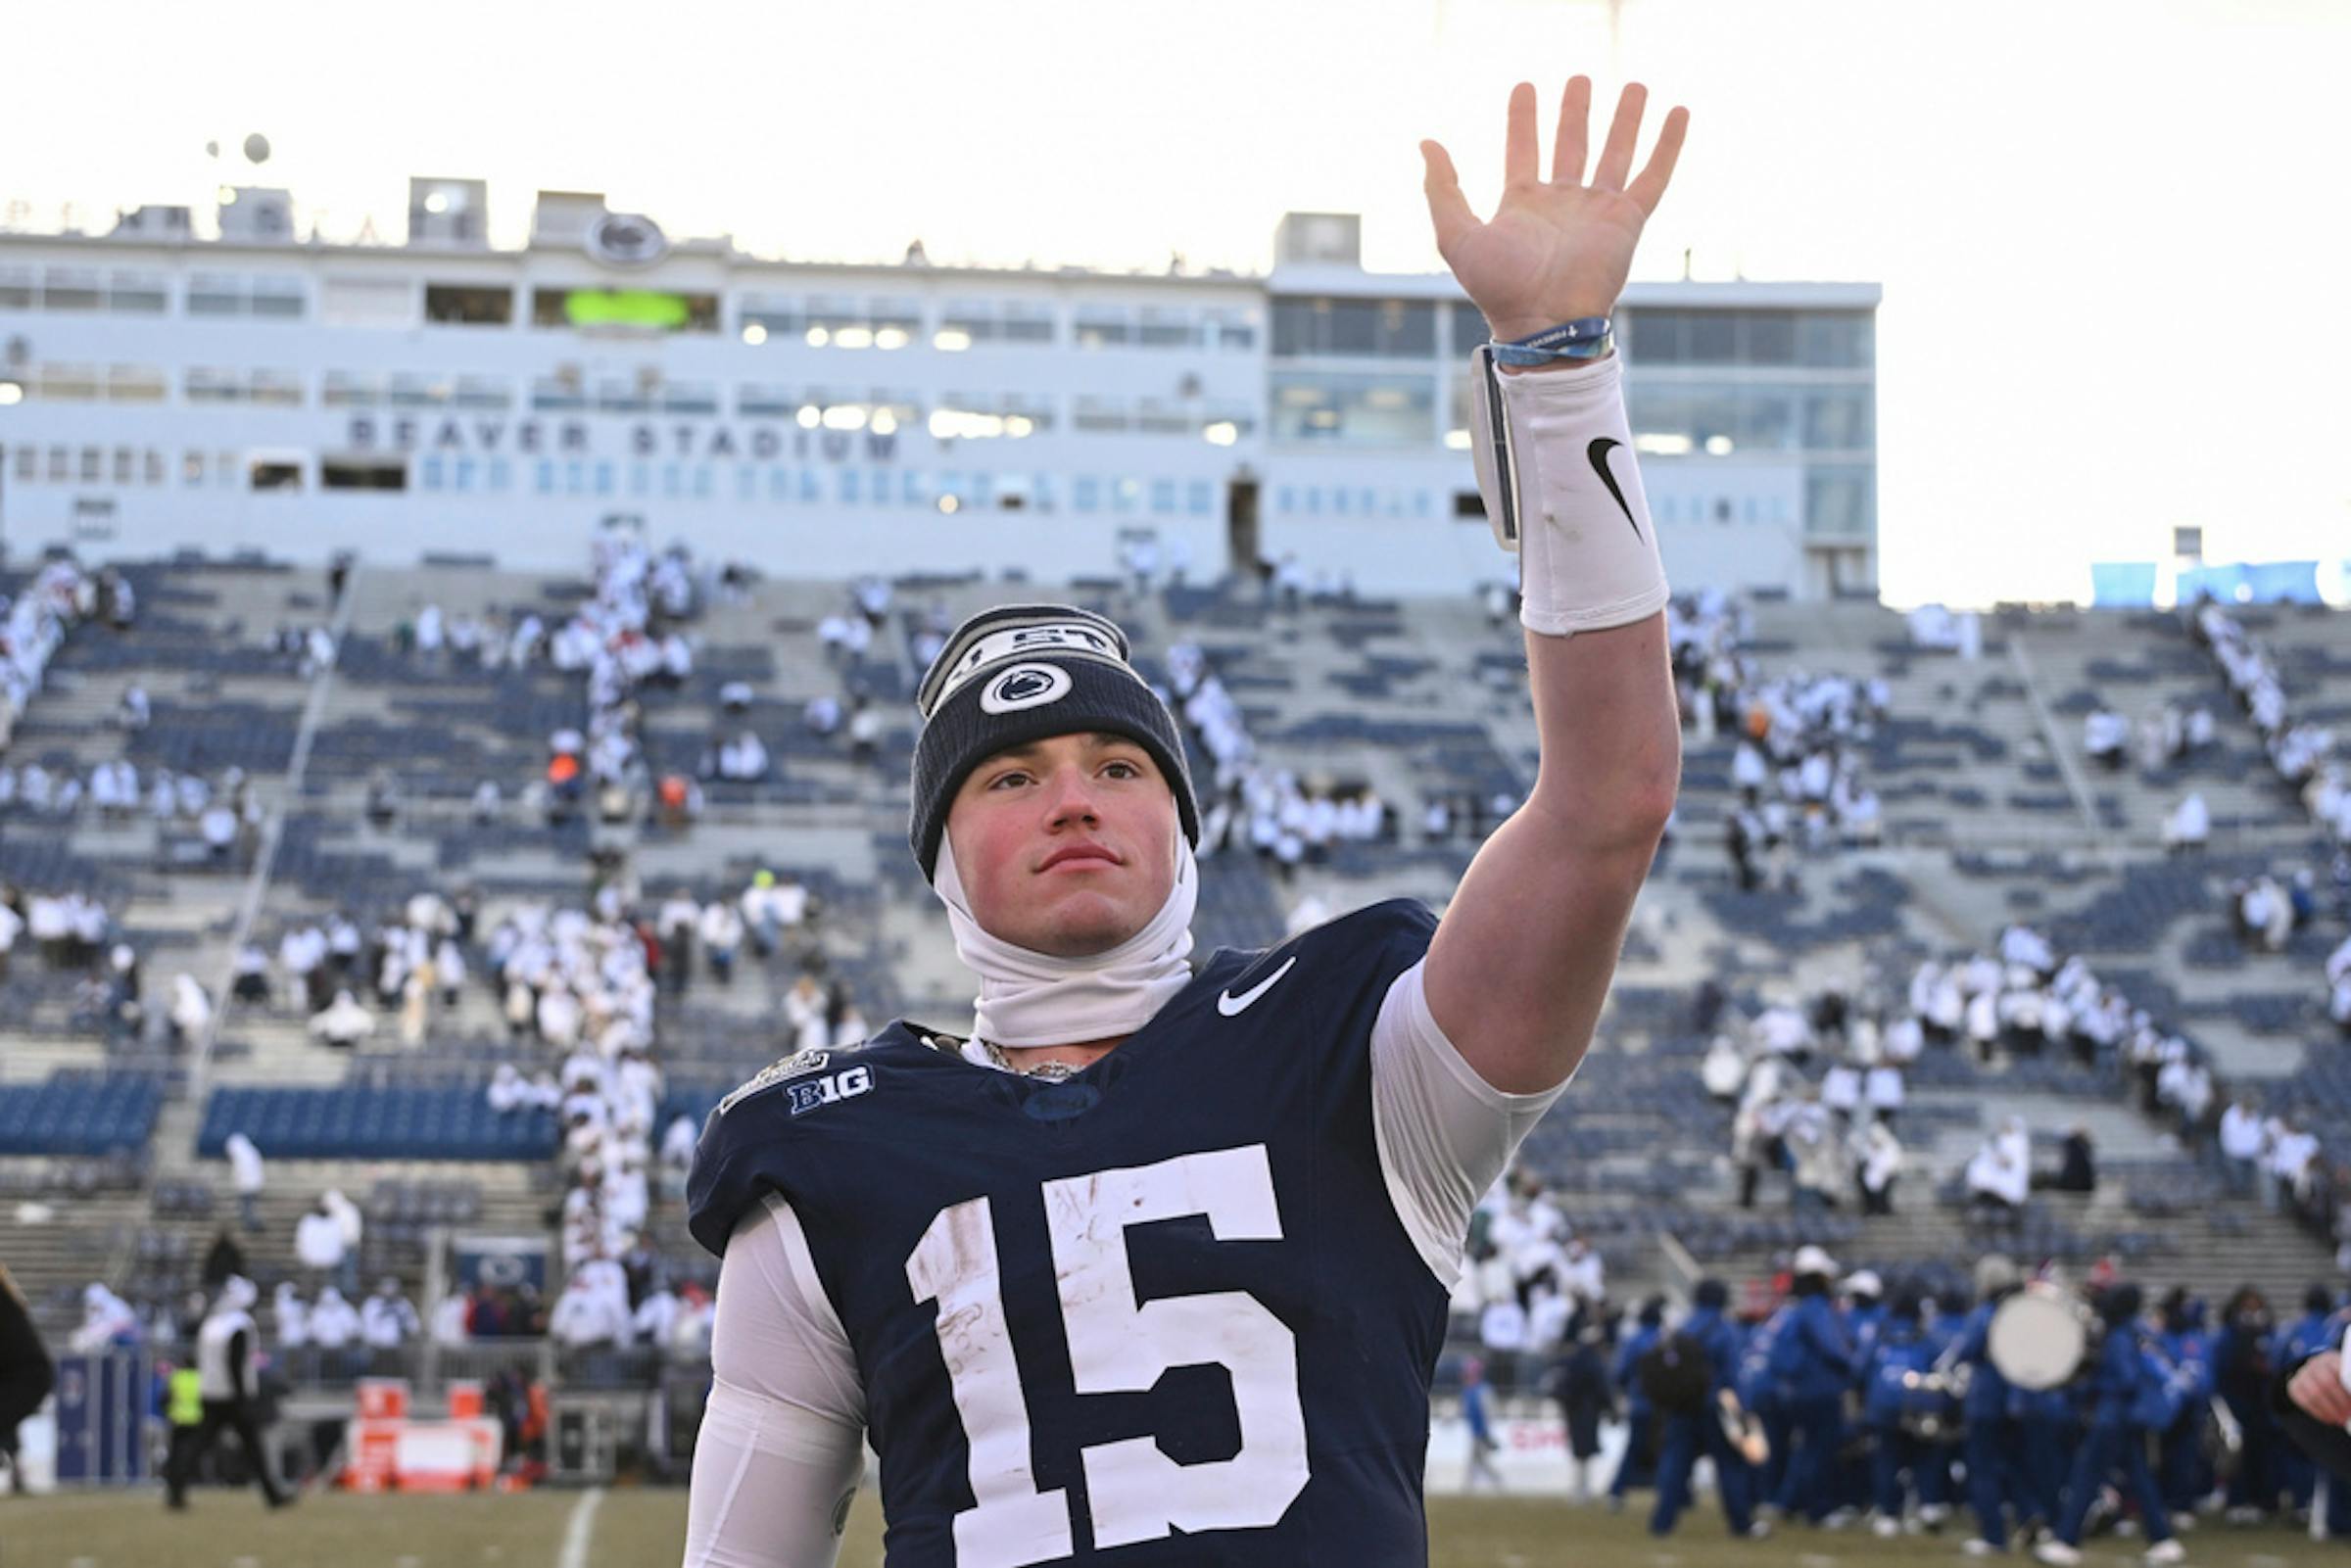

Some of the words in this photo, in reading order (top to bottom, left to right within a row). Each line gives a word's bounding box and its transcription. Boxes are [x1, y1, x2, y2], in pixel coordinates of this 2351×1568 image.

[346, 417, 590, 453] BEAVER
[631, 422, 898, 461] STADIUM
[905, 1143, 1312, 1568] 15
